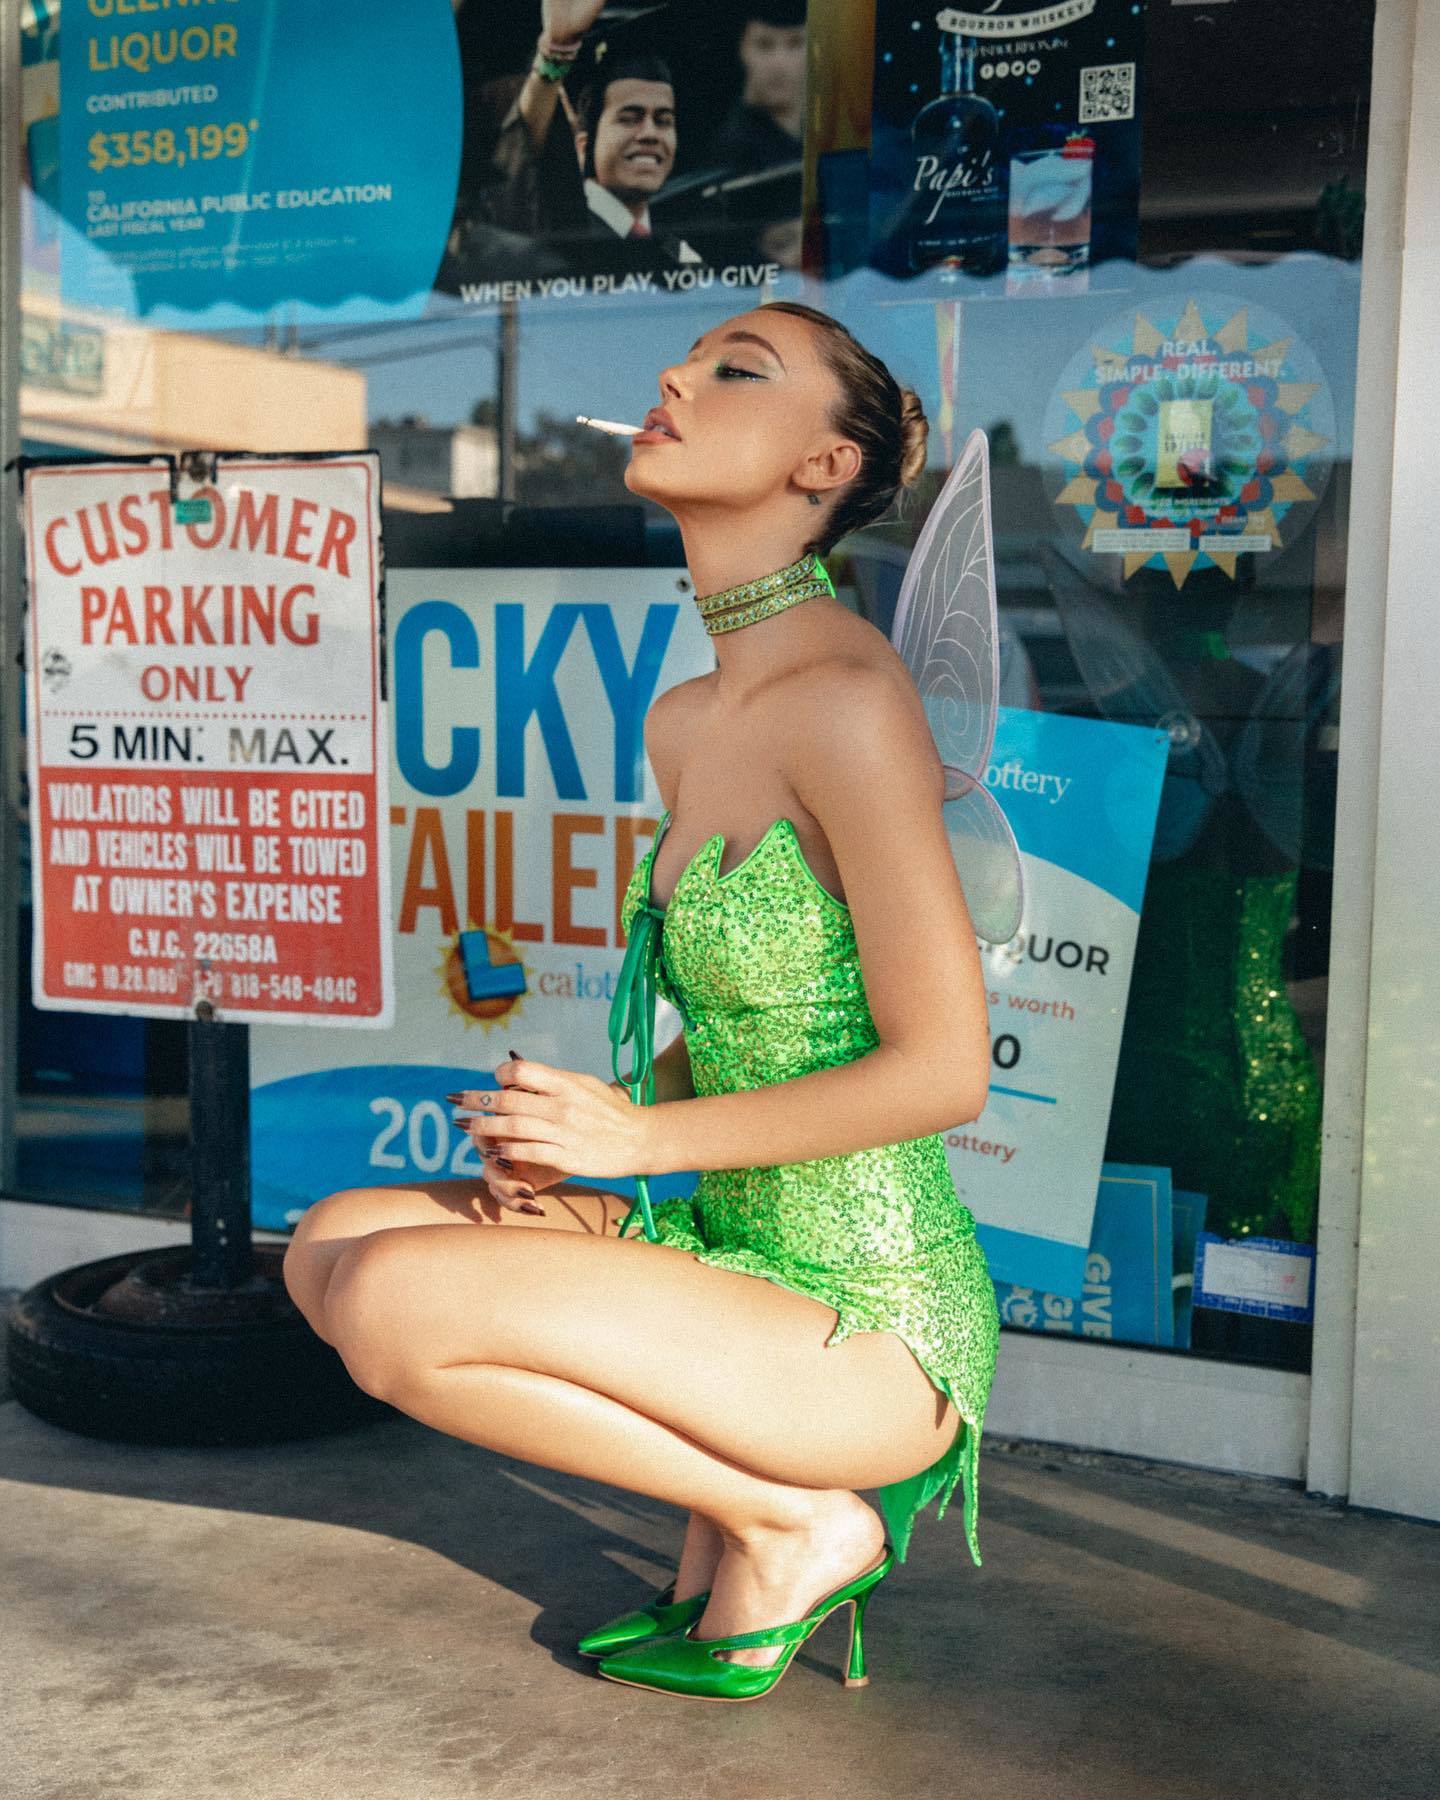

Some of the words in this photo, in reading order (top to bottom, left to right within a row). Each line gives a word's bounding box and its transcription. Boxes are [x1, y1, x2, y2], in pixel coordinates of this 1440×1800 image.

[951, 17, 1015, 31] BOURBON
[1020, 3, 1086, 27] WHISKEY
[88, 24, 237, 72] LIQUOR
[87, 85, 218, 113] CONTRIBUTED
[87, 198, 198, 222] CALIFORNIA
[201, 192, 271, 213] PUBLIC
[276, 184, 392, 209] EDUCATION
[913, 150, 994, 225] Papi's
[460, 279, 534, 304] WHEN
[537, 275, 586, 298] YOU
[593, 271, 657, 296] PLAY,
[663, 269, 714, 291] YOU
[721, 264, 780, 288] GIVE
[44, 486, 358, 578] CUSTOMER
[79, 583, 321, 647] PARKING
[140, 665, 253, 703] ONLY
[394, 600, 680, 802] CKY
[68, 724, 100, 760] 5
[228, 727, 349, 766] MAX.
[982, 762, 1071, 804] ottery
[48, 783, 173, 824] VIOLATORS
[179, 786, 241, 826] WILL
[248, 789, 281, 828] BE
[290, 790, 366, 830] CITED
[49, 828, 90, 867] AND
[96, 829, 189, 870] VEHICLES
[195, 833, 246, 873] WILL
[253, 836, 281, 875] BE
[288, 837, 367, 877] TOWED
[389, 805, 668, 950] AILE
[71, 875, 103, 913] AT
[109, 877, 217, 920] OWNER'S
[225, 881, 343, 924] EXPENSE
[128, 928, 186, 959] C.V.C.
[193, 931, 278, 964] 22658A
[538, 962, 621, 1000] calot
[1007, 994, 1075, 1021] worth
[368, 1096, 486, 1176] 202
[946, 1134, 1017, 1163] ottery
